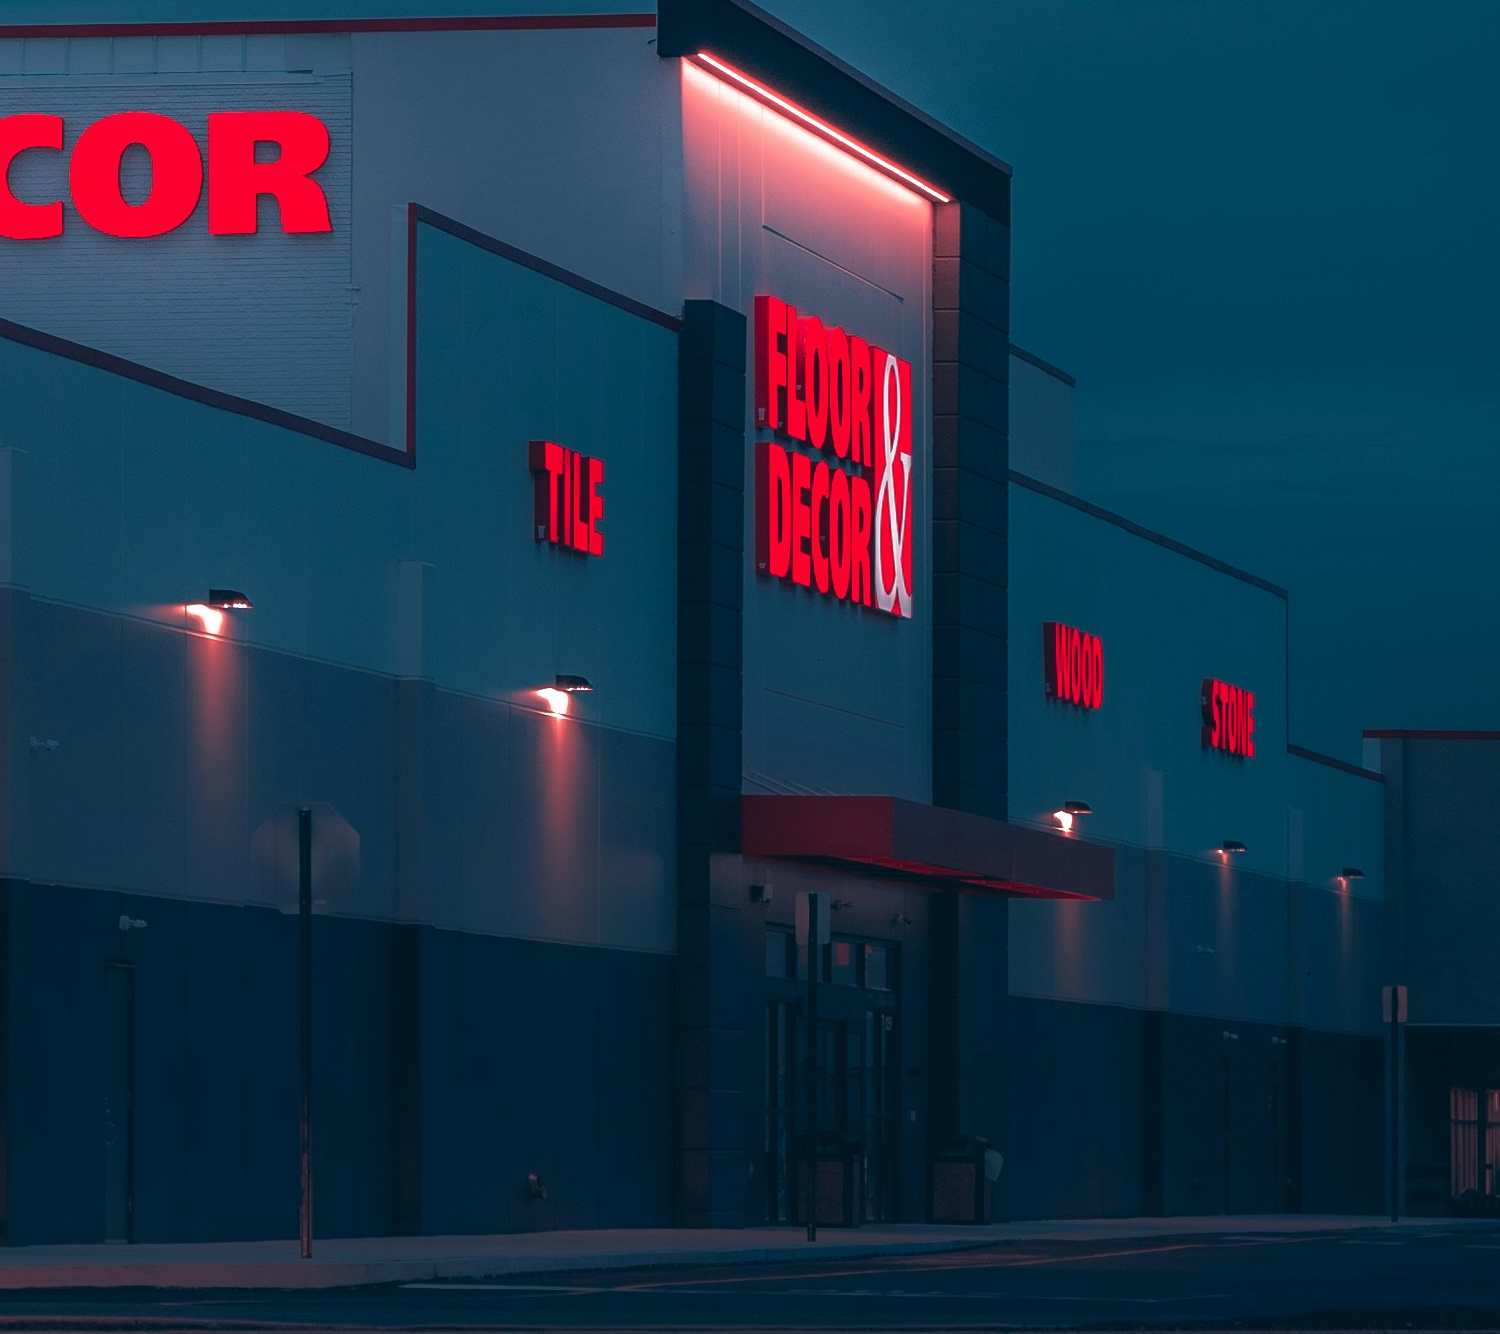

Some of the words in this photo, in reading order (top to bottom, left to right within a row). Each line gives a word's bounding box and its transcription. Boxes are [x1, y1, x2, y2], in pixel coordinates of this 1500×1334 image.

[767, 296, 872, 468] FLOOR
[543, 440, 605, 557] TILE
[767, 442, 872, 608] DECOR
[874, 353, 913, 619] &
[1054, 621, 1104, 710] WOOD
[1211, 677, 1256, 759] STONE
